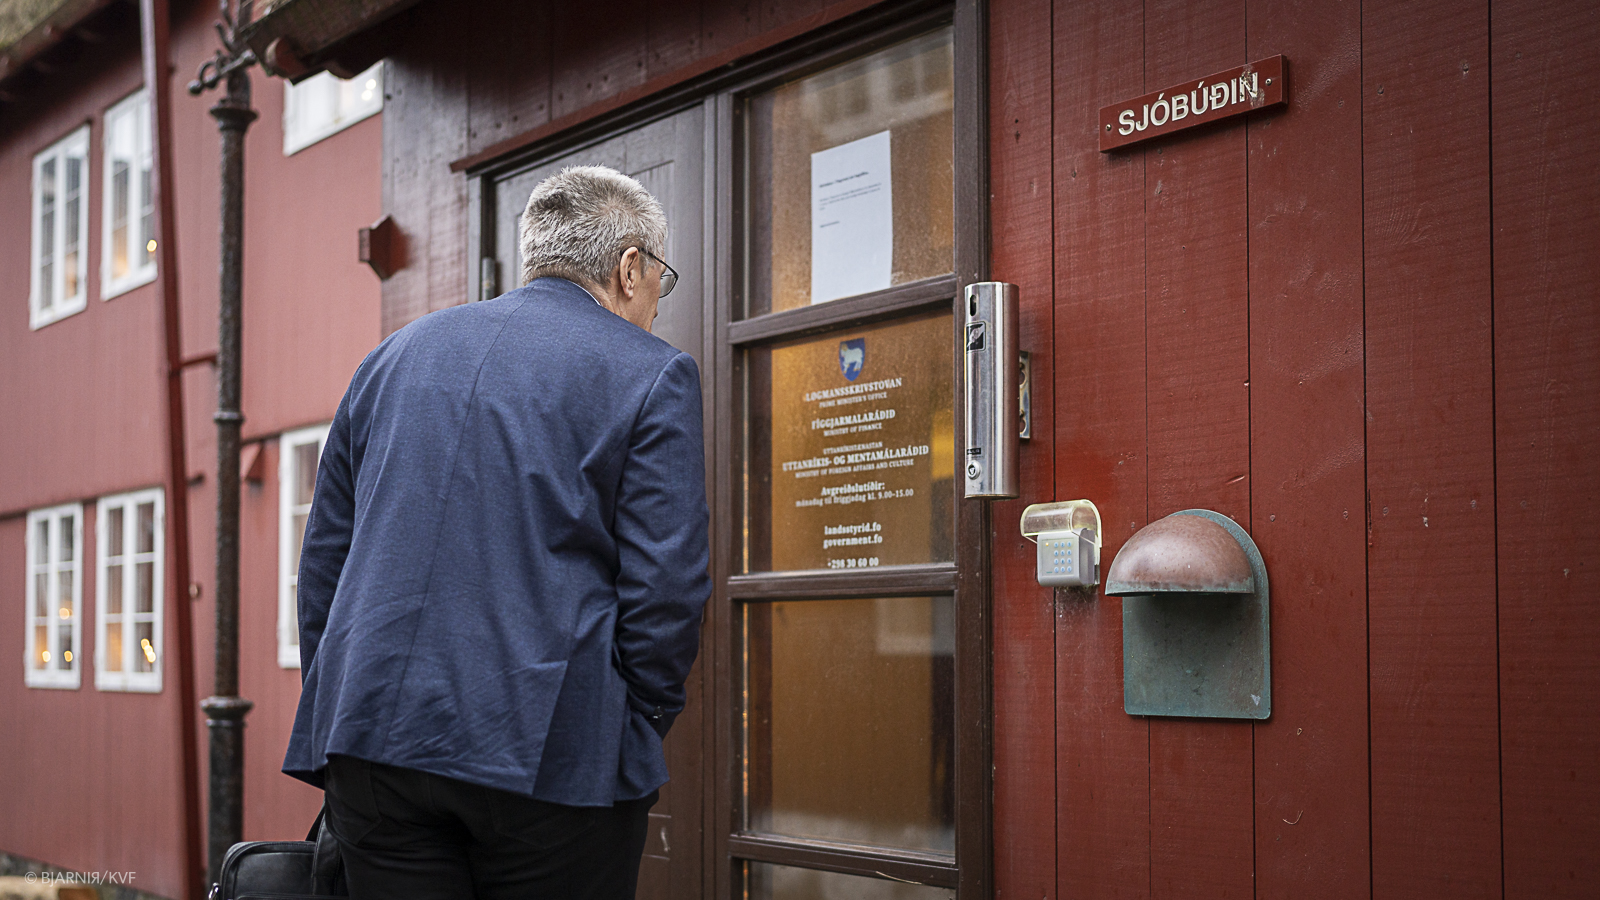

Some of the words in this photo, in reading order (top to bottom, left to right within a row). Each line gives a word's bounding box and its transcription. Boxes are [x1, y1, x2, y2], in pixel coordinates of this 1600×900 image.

[1118, 72, 1259, 136] SJÓBÚÐIN
[823, 427, 849, 437] MINISTRY
[858, 422, 883, 432] FINANCE
[833, 455, 846, 466] OG
[795, 469, 820, 479] MINISTRY
[888, 458, 914, 468] CULTURE
[823, 534, 883, 549] government.fo
[847, 558, 857, 568] 30
[868, 556, 879, 566] 00
